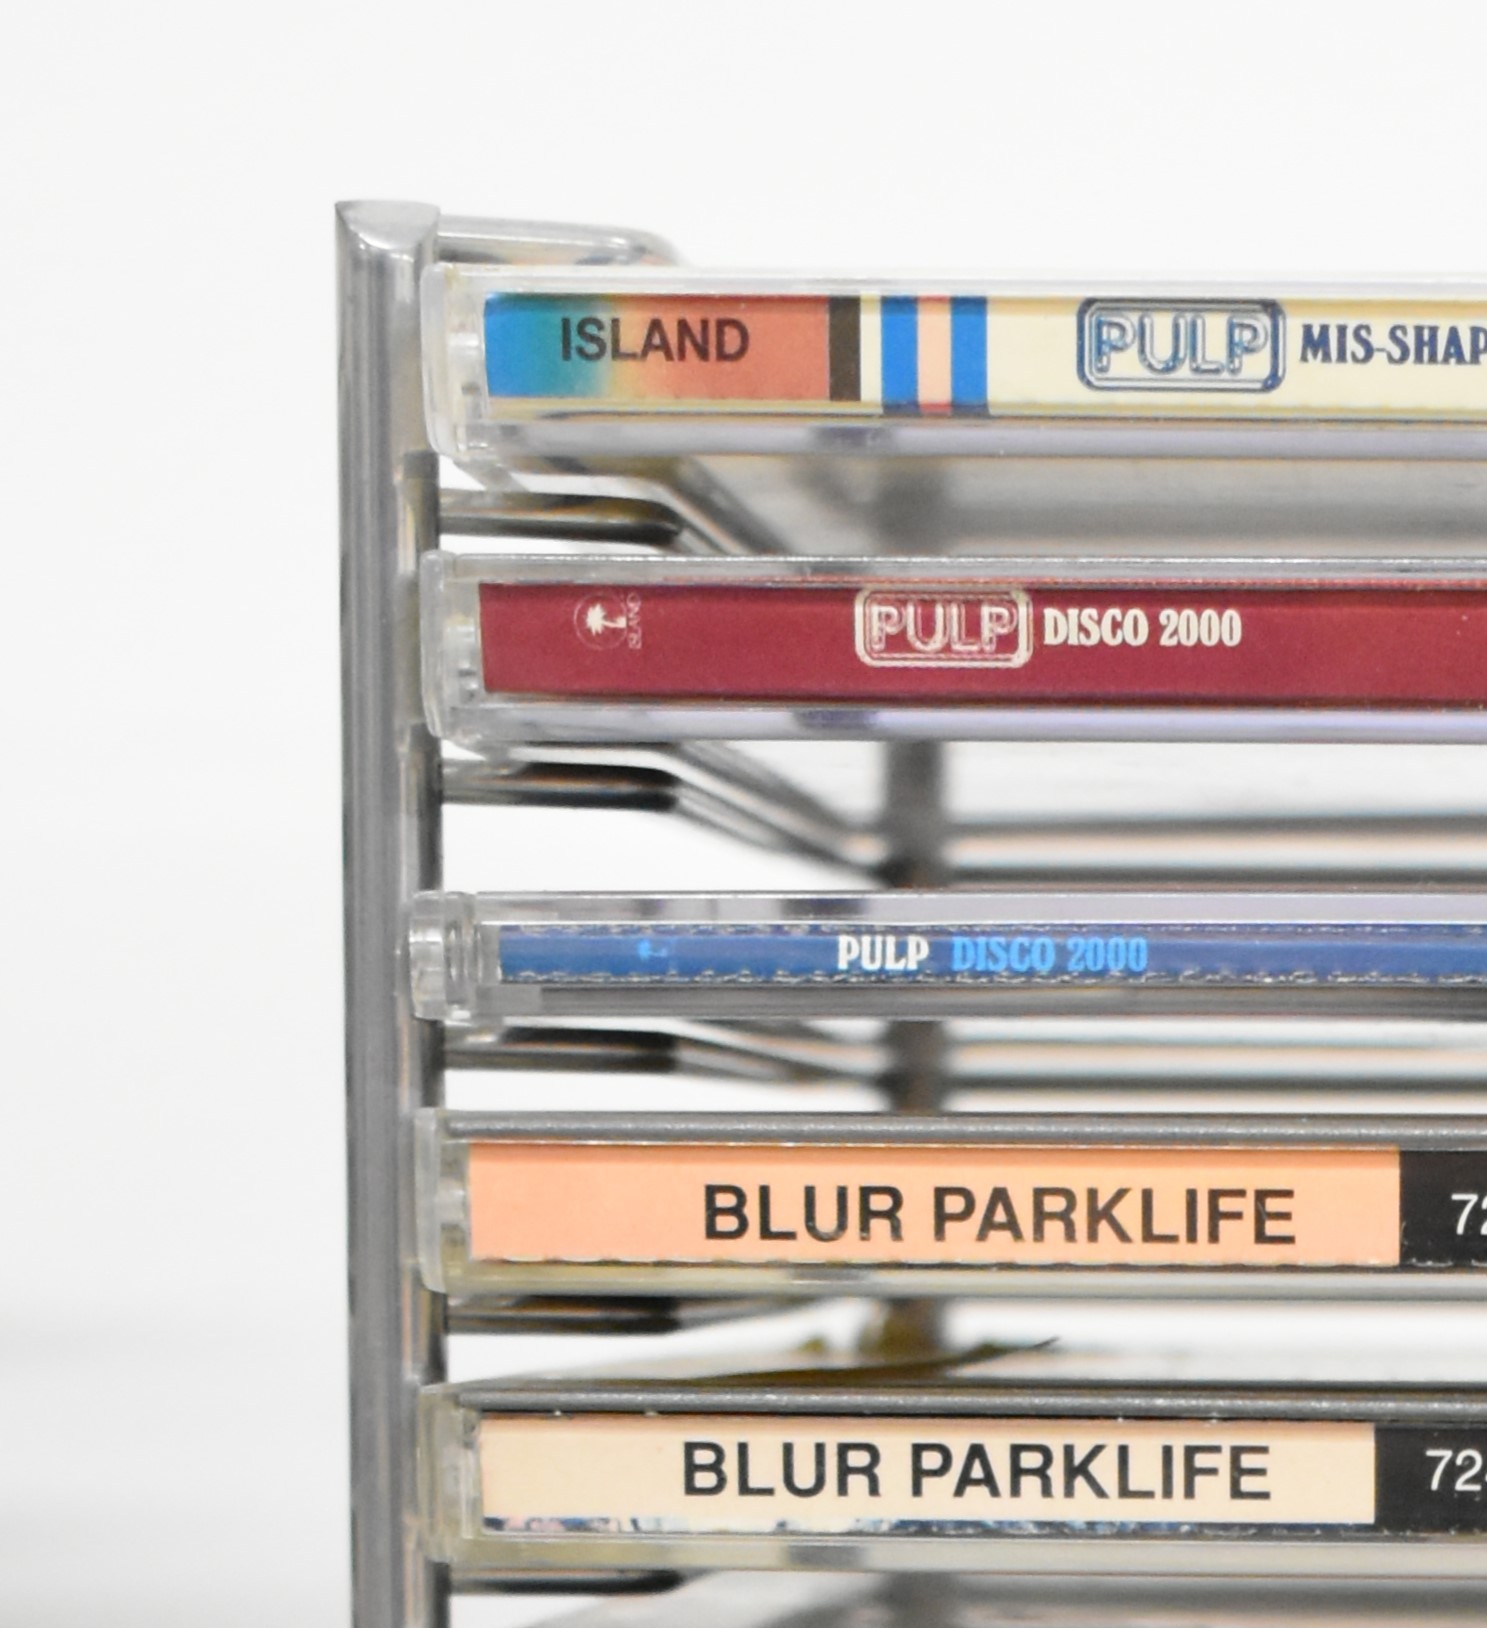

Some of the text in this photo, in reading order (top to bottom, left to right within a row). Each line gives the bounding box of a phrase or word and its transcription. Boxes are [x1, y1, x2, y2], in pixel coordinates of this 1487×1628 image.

[559, 317, 750, 364] ISLAND
[1094, 311, 1268, 377] PULP
[870, 599, 1241, 651] PULP DISCO 2000
[838, 935, 1147, 972] PULP DISCO 2000
[705, 1184, 1295, 1245] BLUR PARKLIFE
[683, 1441, 1272, 1501] BLUR PARKLIFE
